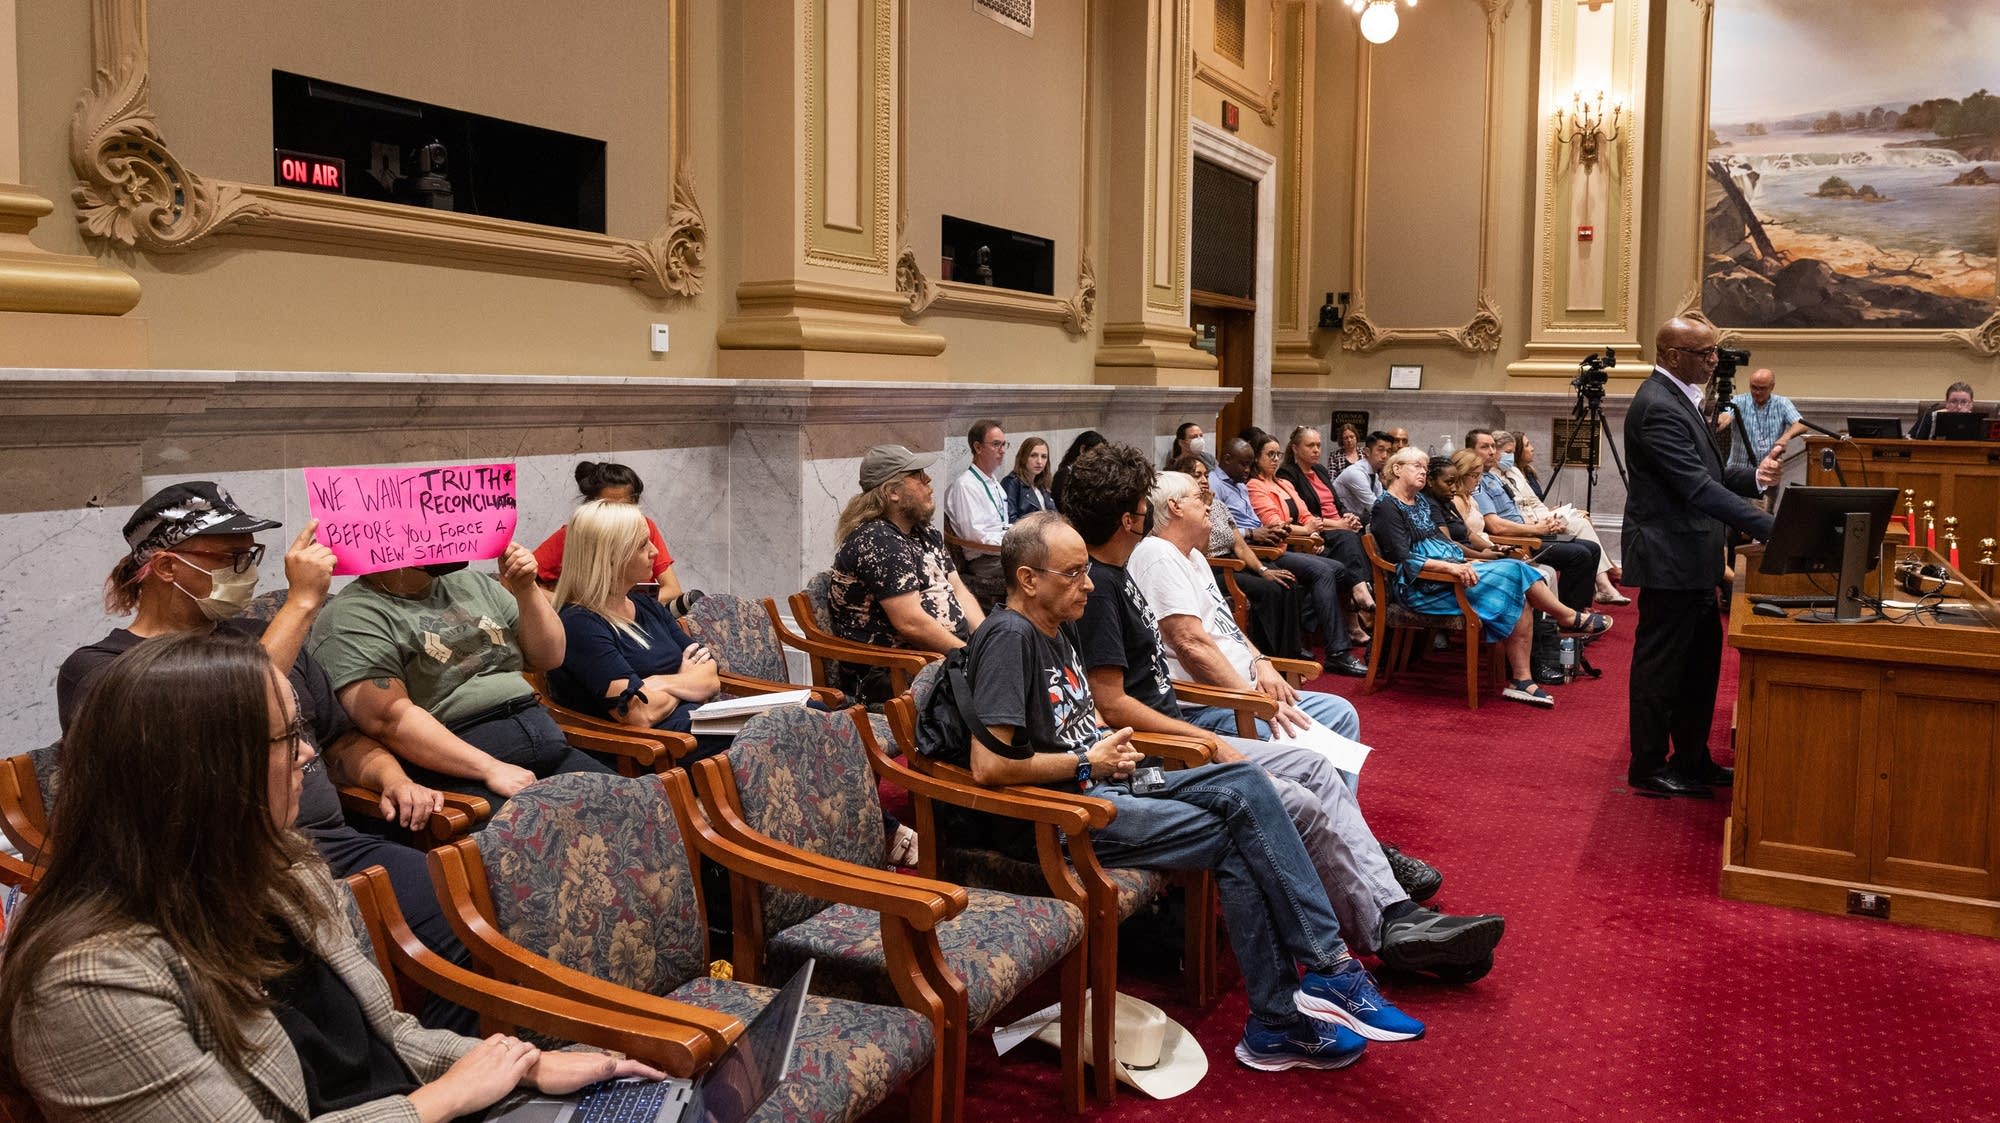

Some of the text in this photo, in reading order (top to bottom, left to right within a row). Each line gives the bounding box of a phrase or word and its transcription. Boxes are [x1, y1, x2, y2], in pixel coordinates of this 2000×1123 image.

[282, 159, 339, 188] ON AIR
[312, 476, 346, 511] WE
[355, 474, 417, 512] WANT
[418, 468, 500, 492] TRUTH
[325, 519, 507, 549] BEFORE YOU FORCE A
[370, 539, 478, 565] NEW STATION
